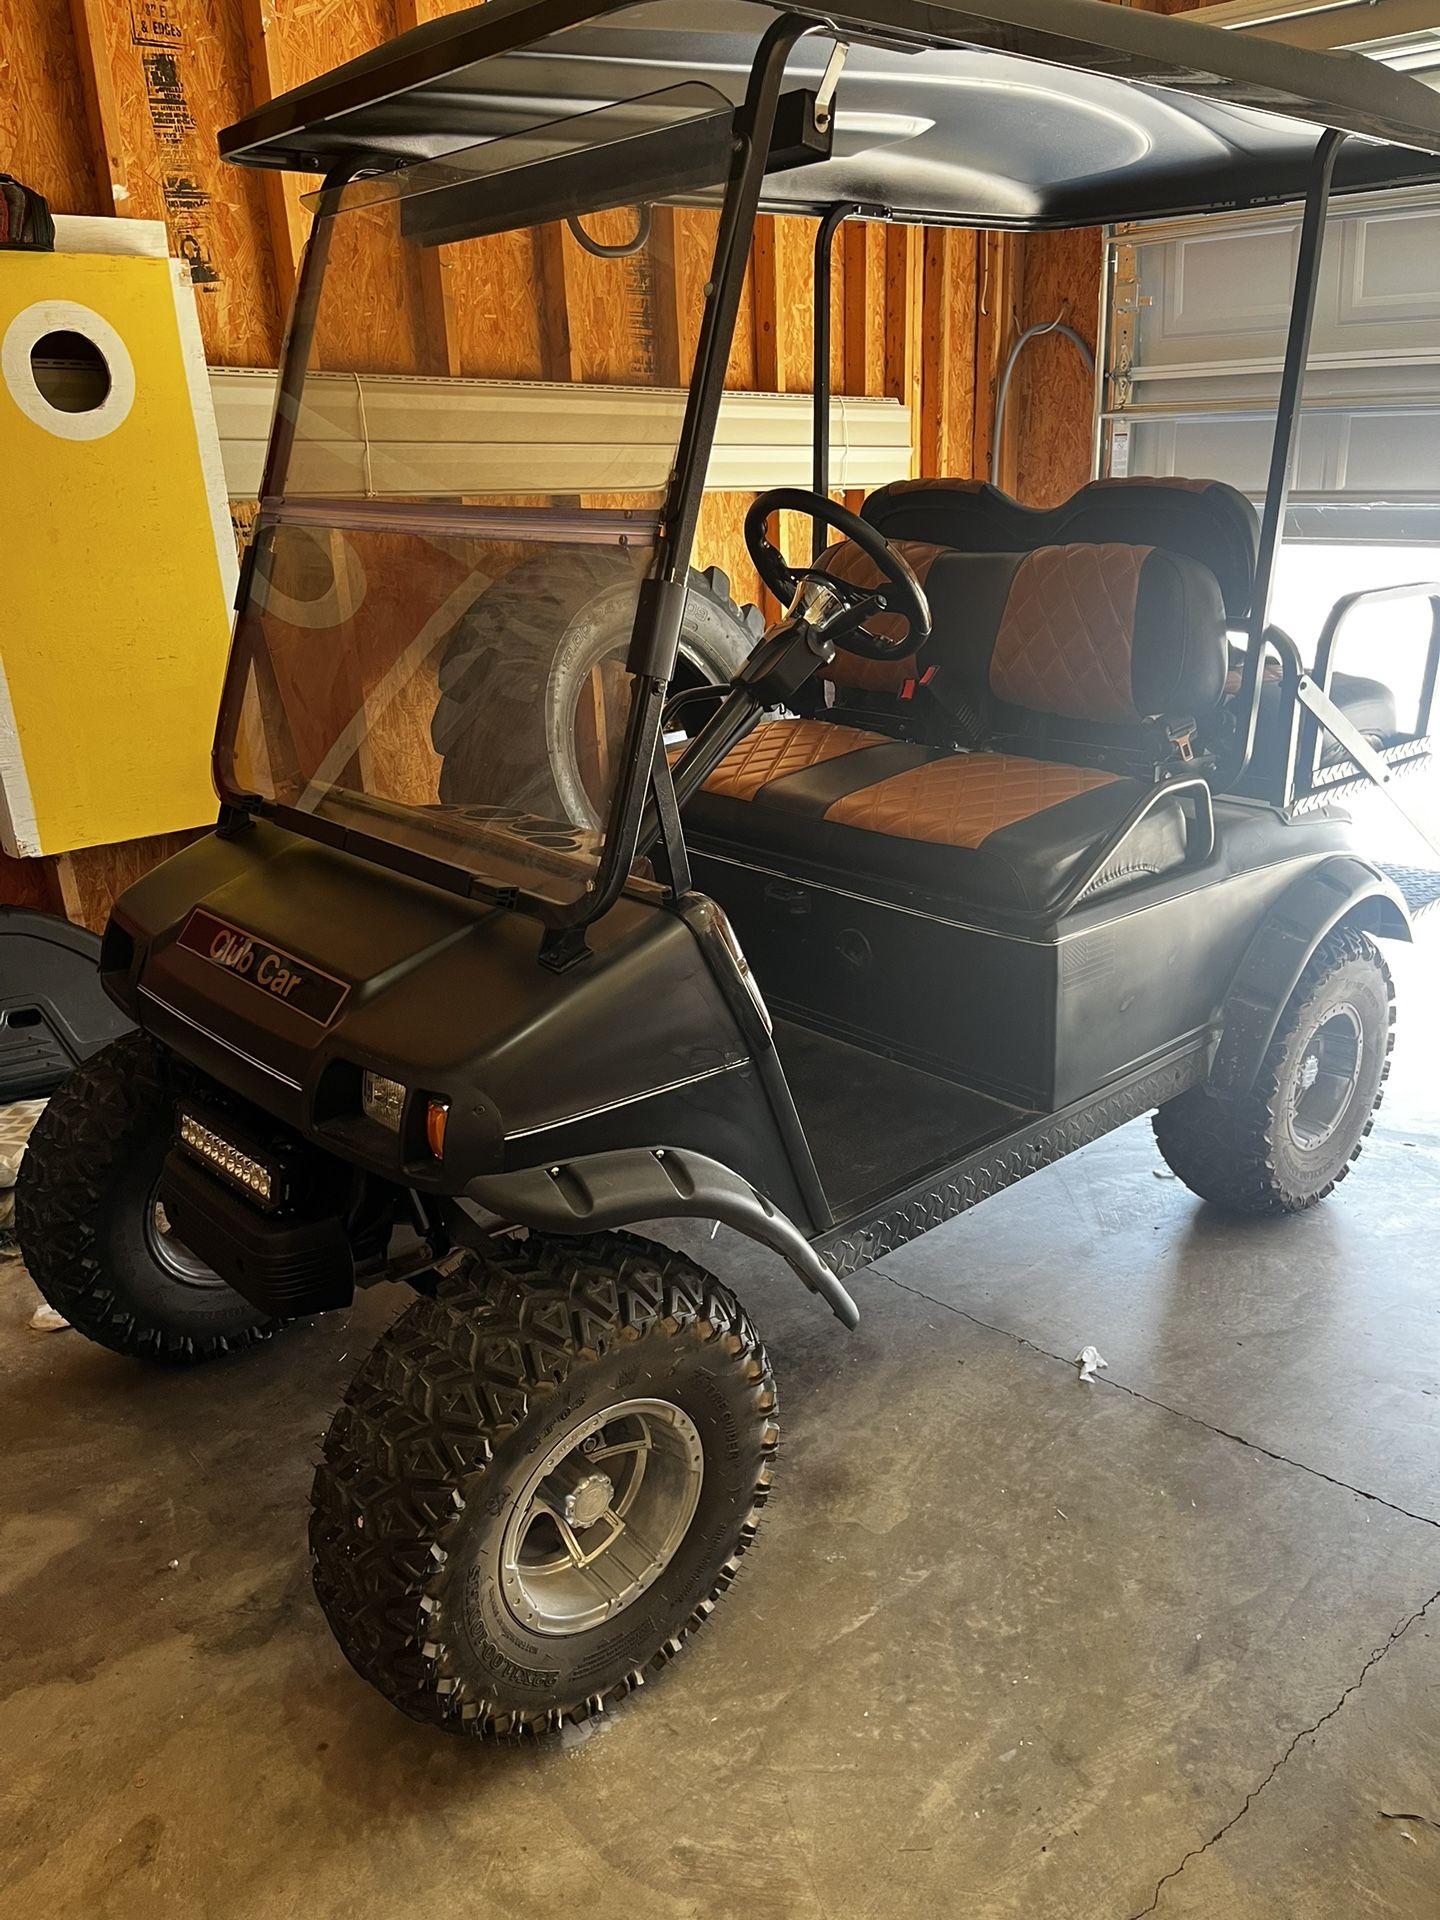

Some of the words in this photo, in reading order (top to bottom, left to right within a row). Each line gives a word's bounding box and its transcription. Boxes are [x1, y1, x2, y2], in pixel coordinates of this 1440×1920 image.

[141, 20, 148, 33] &
[153, 21, 182, 38] EDGES
[210, 929, 254, 974] Club
[257, 954, 302, 997] Car
